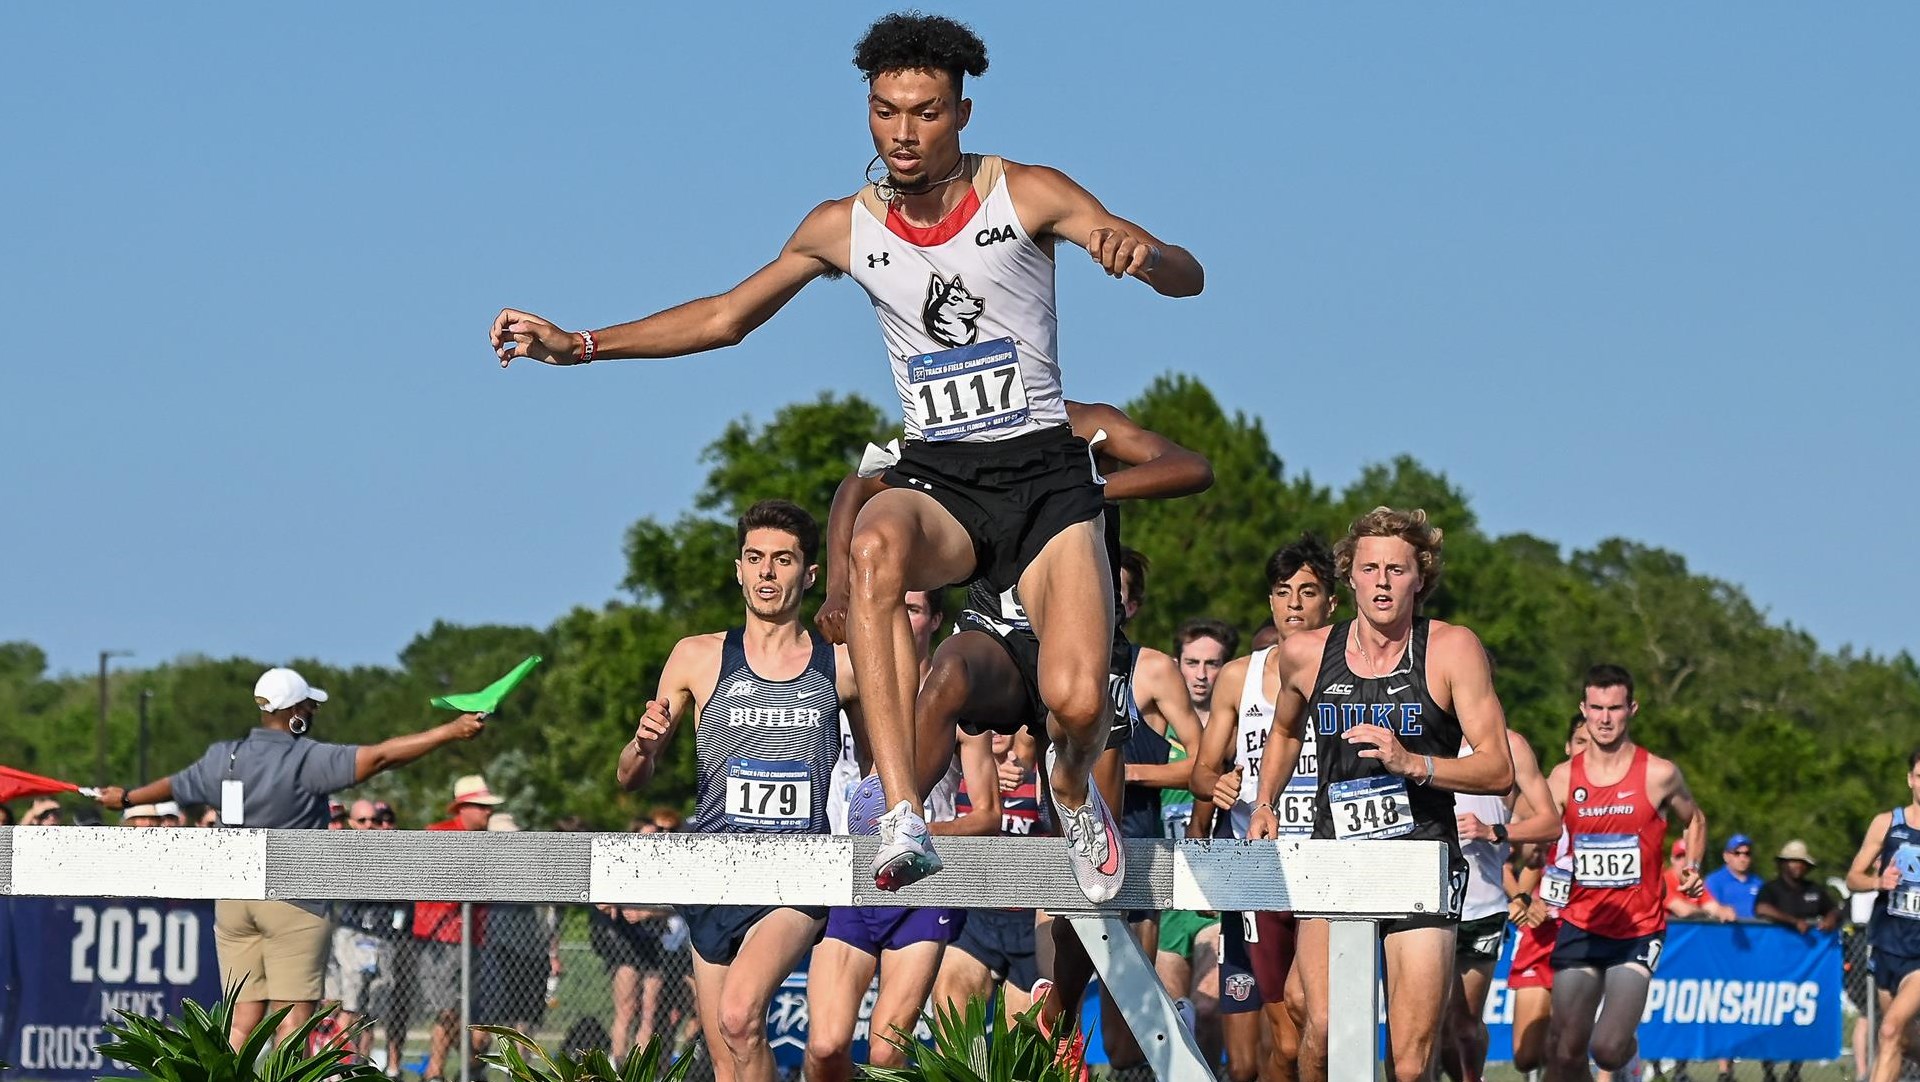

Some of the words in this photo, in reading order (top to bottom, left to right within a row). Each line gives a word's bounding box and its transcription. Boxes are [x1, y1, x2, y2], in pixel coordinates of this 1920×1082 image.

[975, 225, 1017, 247] CAA
[925, 368, 944, 377] TRACK
[948, 363, 963, 372] FIELD
[965, 352, 1012, 369] CHAMPIONSHIPS
[919, 367, 1017, 426] 1117
[1323, 684, 1354, 695] ACC
[728, 708, 821, 727] BUTLER
[1317, 703, 1422, 736] DUKE
[740, 782, 797, 815] 179
[1344, 796, 1399, 832] 348
[1578, 804, 1635, 818] SAMFORD
[1580, 853, 1635, 876] 1362
[71, 905, 200, 985] 2020
[100, 991, 165, 1023] MEN'S
[1641, 978, 1820, 1026] PIONSHIPS
[20, 1024, 103, 1069] CROSS
